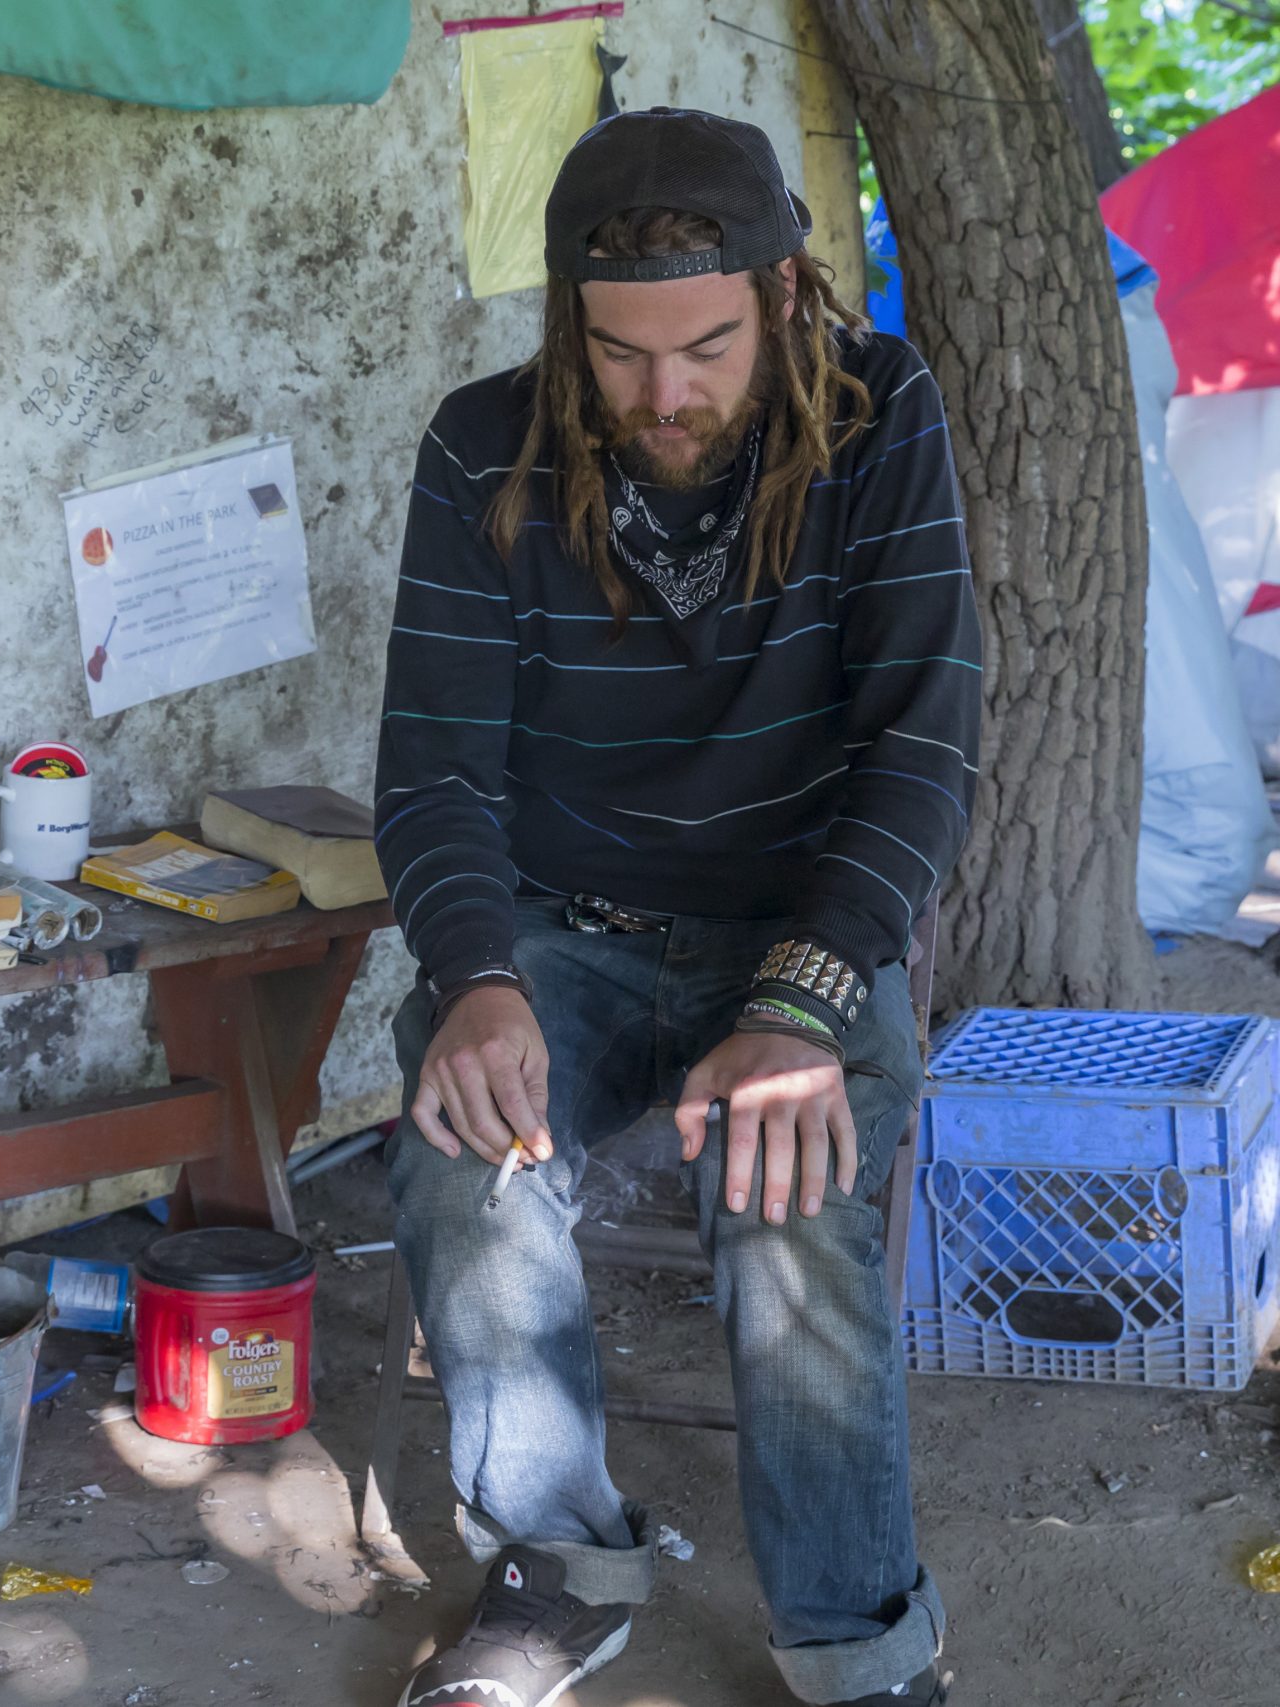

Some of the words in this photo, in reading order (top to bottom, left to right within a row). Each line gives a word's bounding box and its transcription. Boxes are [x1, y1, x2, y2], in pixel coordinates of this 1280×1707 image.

[123, 521, 158, 544] PIZZA
[160, 518, 175, 534] IN
[179, 511, 203, 530] THE
[207, 502, 238, 522] PARK
[228, 1339, 280, 1362] Folgers
[223, 1360, 282, 1378] COUNTRY
[233, 1373, 275, 1388] ROAST
